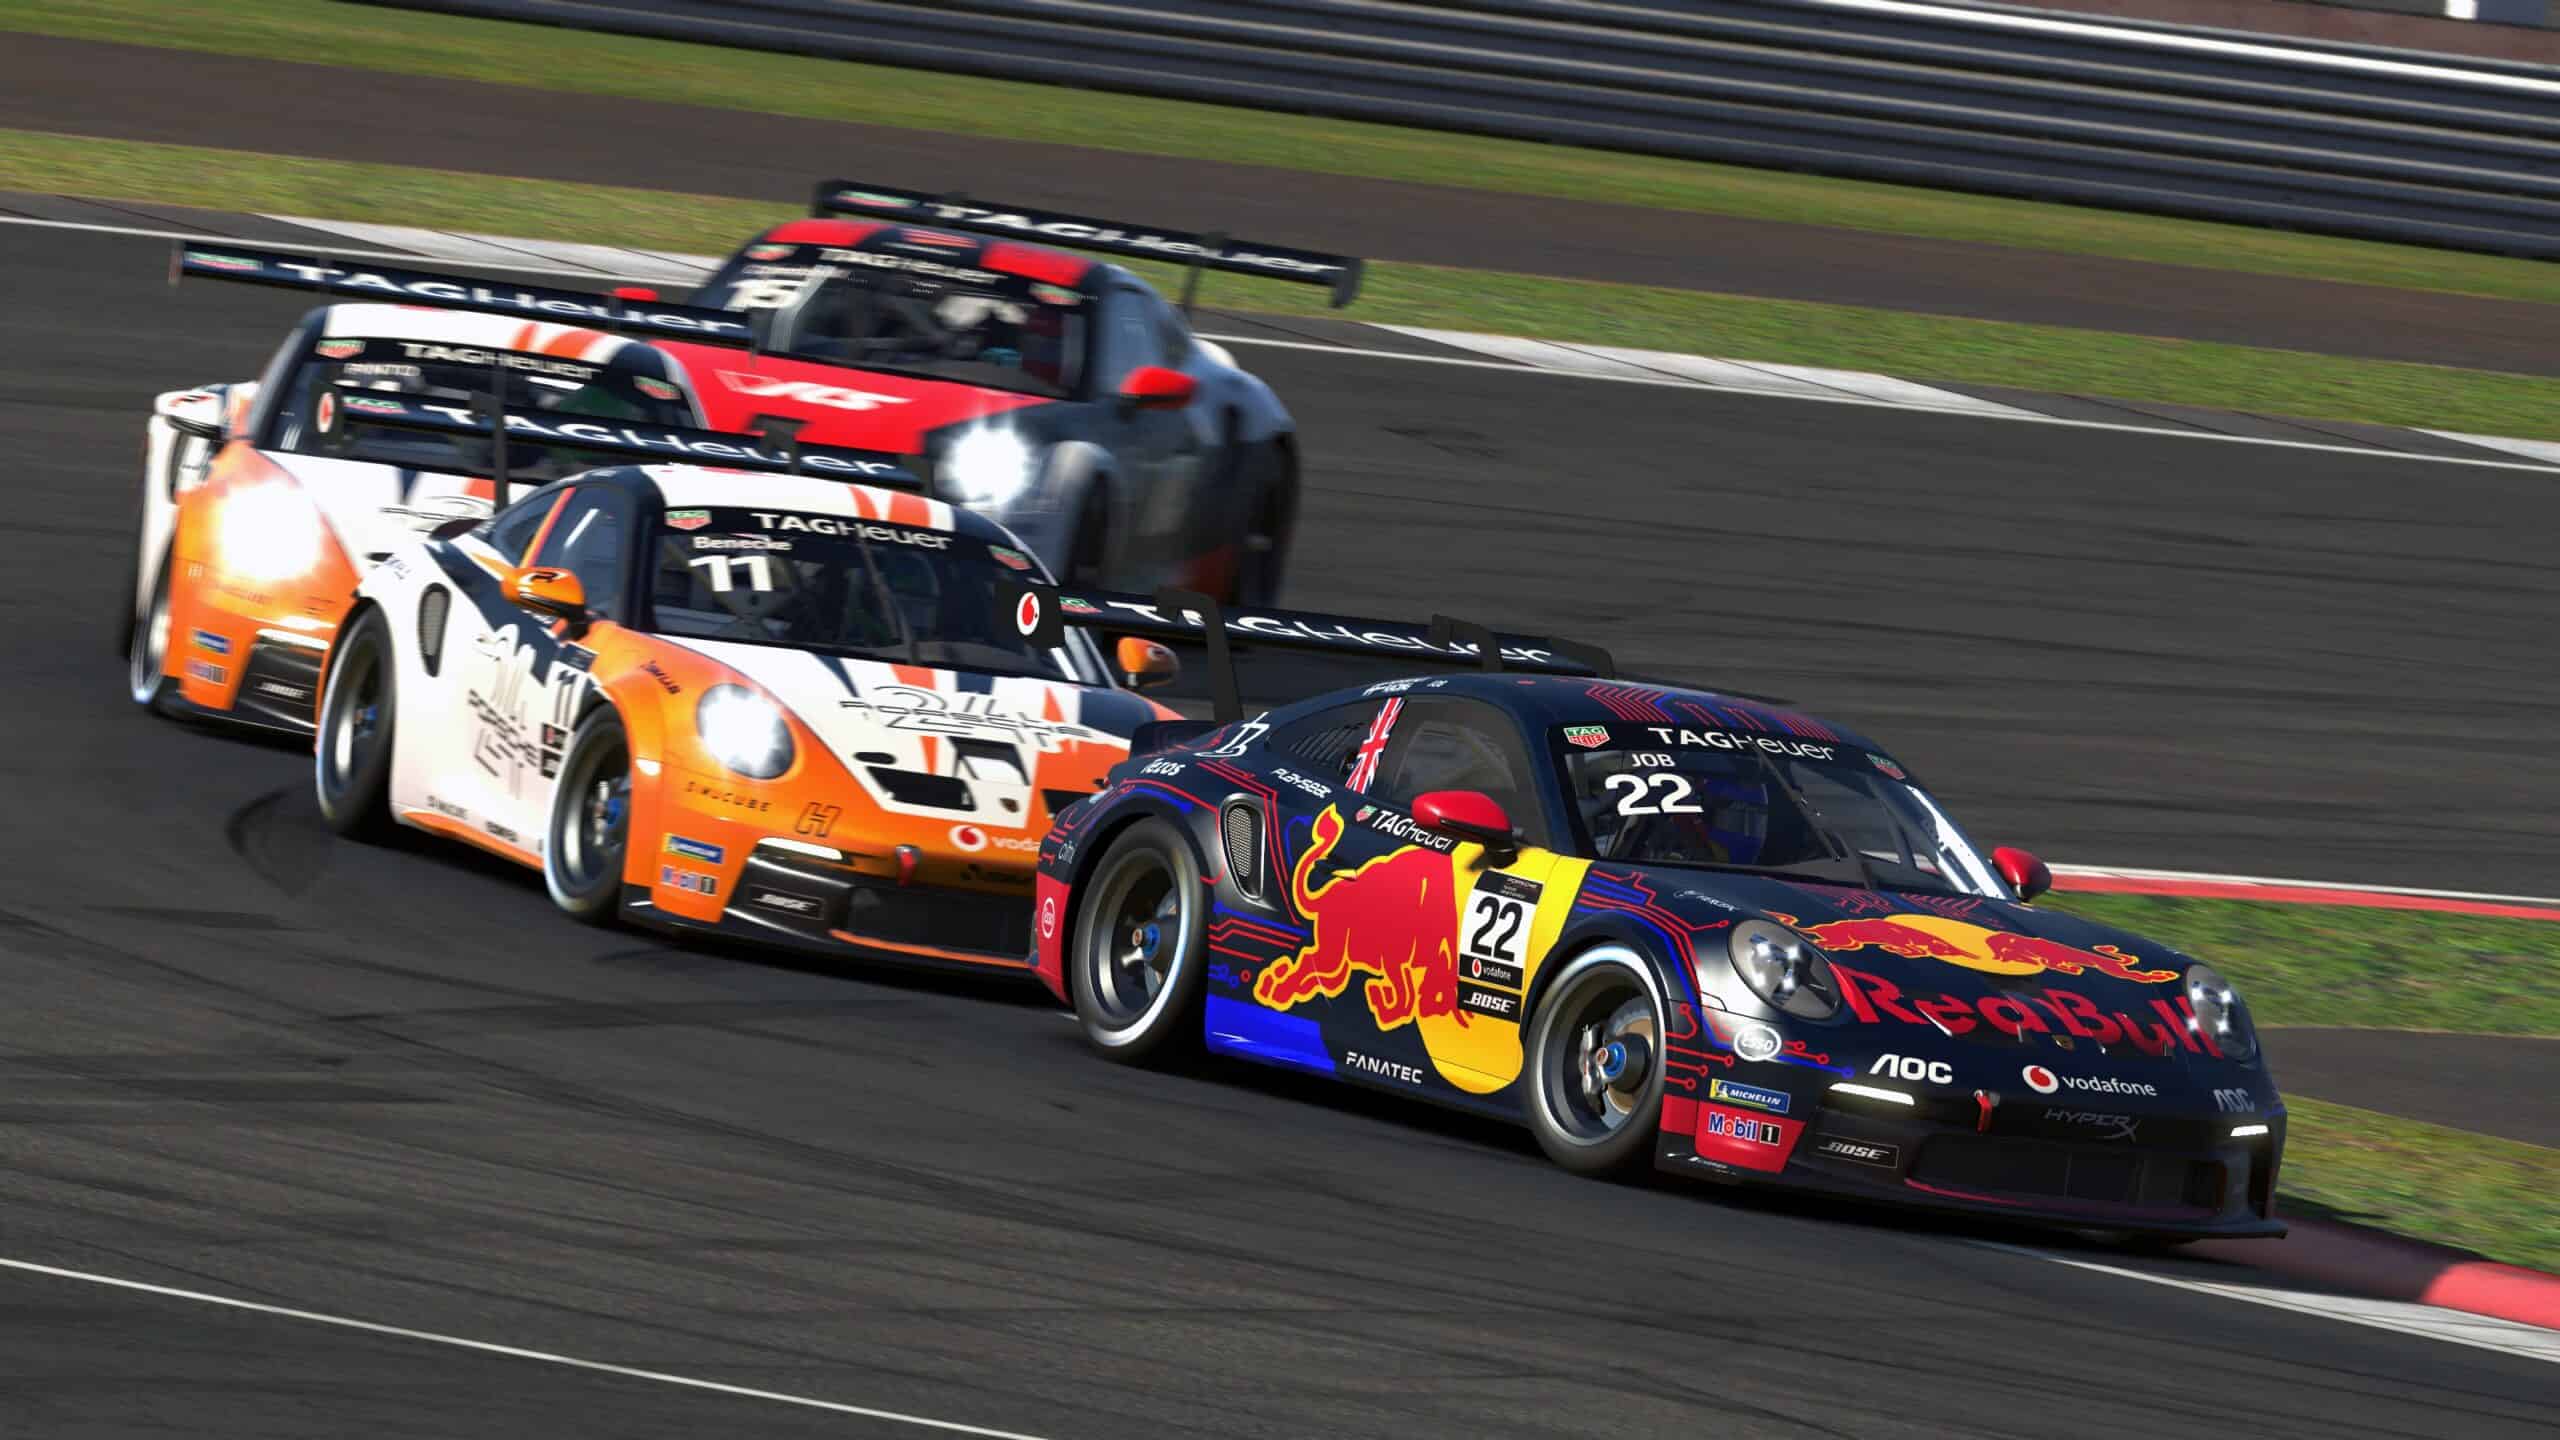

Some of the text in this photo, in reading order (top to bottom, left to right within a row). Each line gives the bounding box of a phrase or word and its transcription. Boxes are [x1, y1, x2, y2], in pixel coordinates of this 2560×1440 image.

[692, 535, 793, 551] Benecke
[751, 512, 953, 551] TAGHeuer
[688, 555, 773, 592] 11
[1648, 727, 1835, 761] TAGHeuer
[1631, 752, 1676, 769] JOB
[1604, 774, 1704, 817] 22
[1470, 895, 1524, 963] 22
[1464, 991, 1517, 1013] BOSE
[1345, 1050, 1423, 1085] FANATEC
[1869, 1053, 1953, 1085] AOC
[1729, 1088, 1784, 1106] MICHELIN
[2061, 1074, 2158, 1097] vodafone
[1707, 1111, 1758, 1141] Mobil
[1818, 1141, 1891, 1161] BOSE
